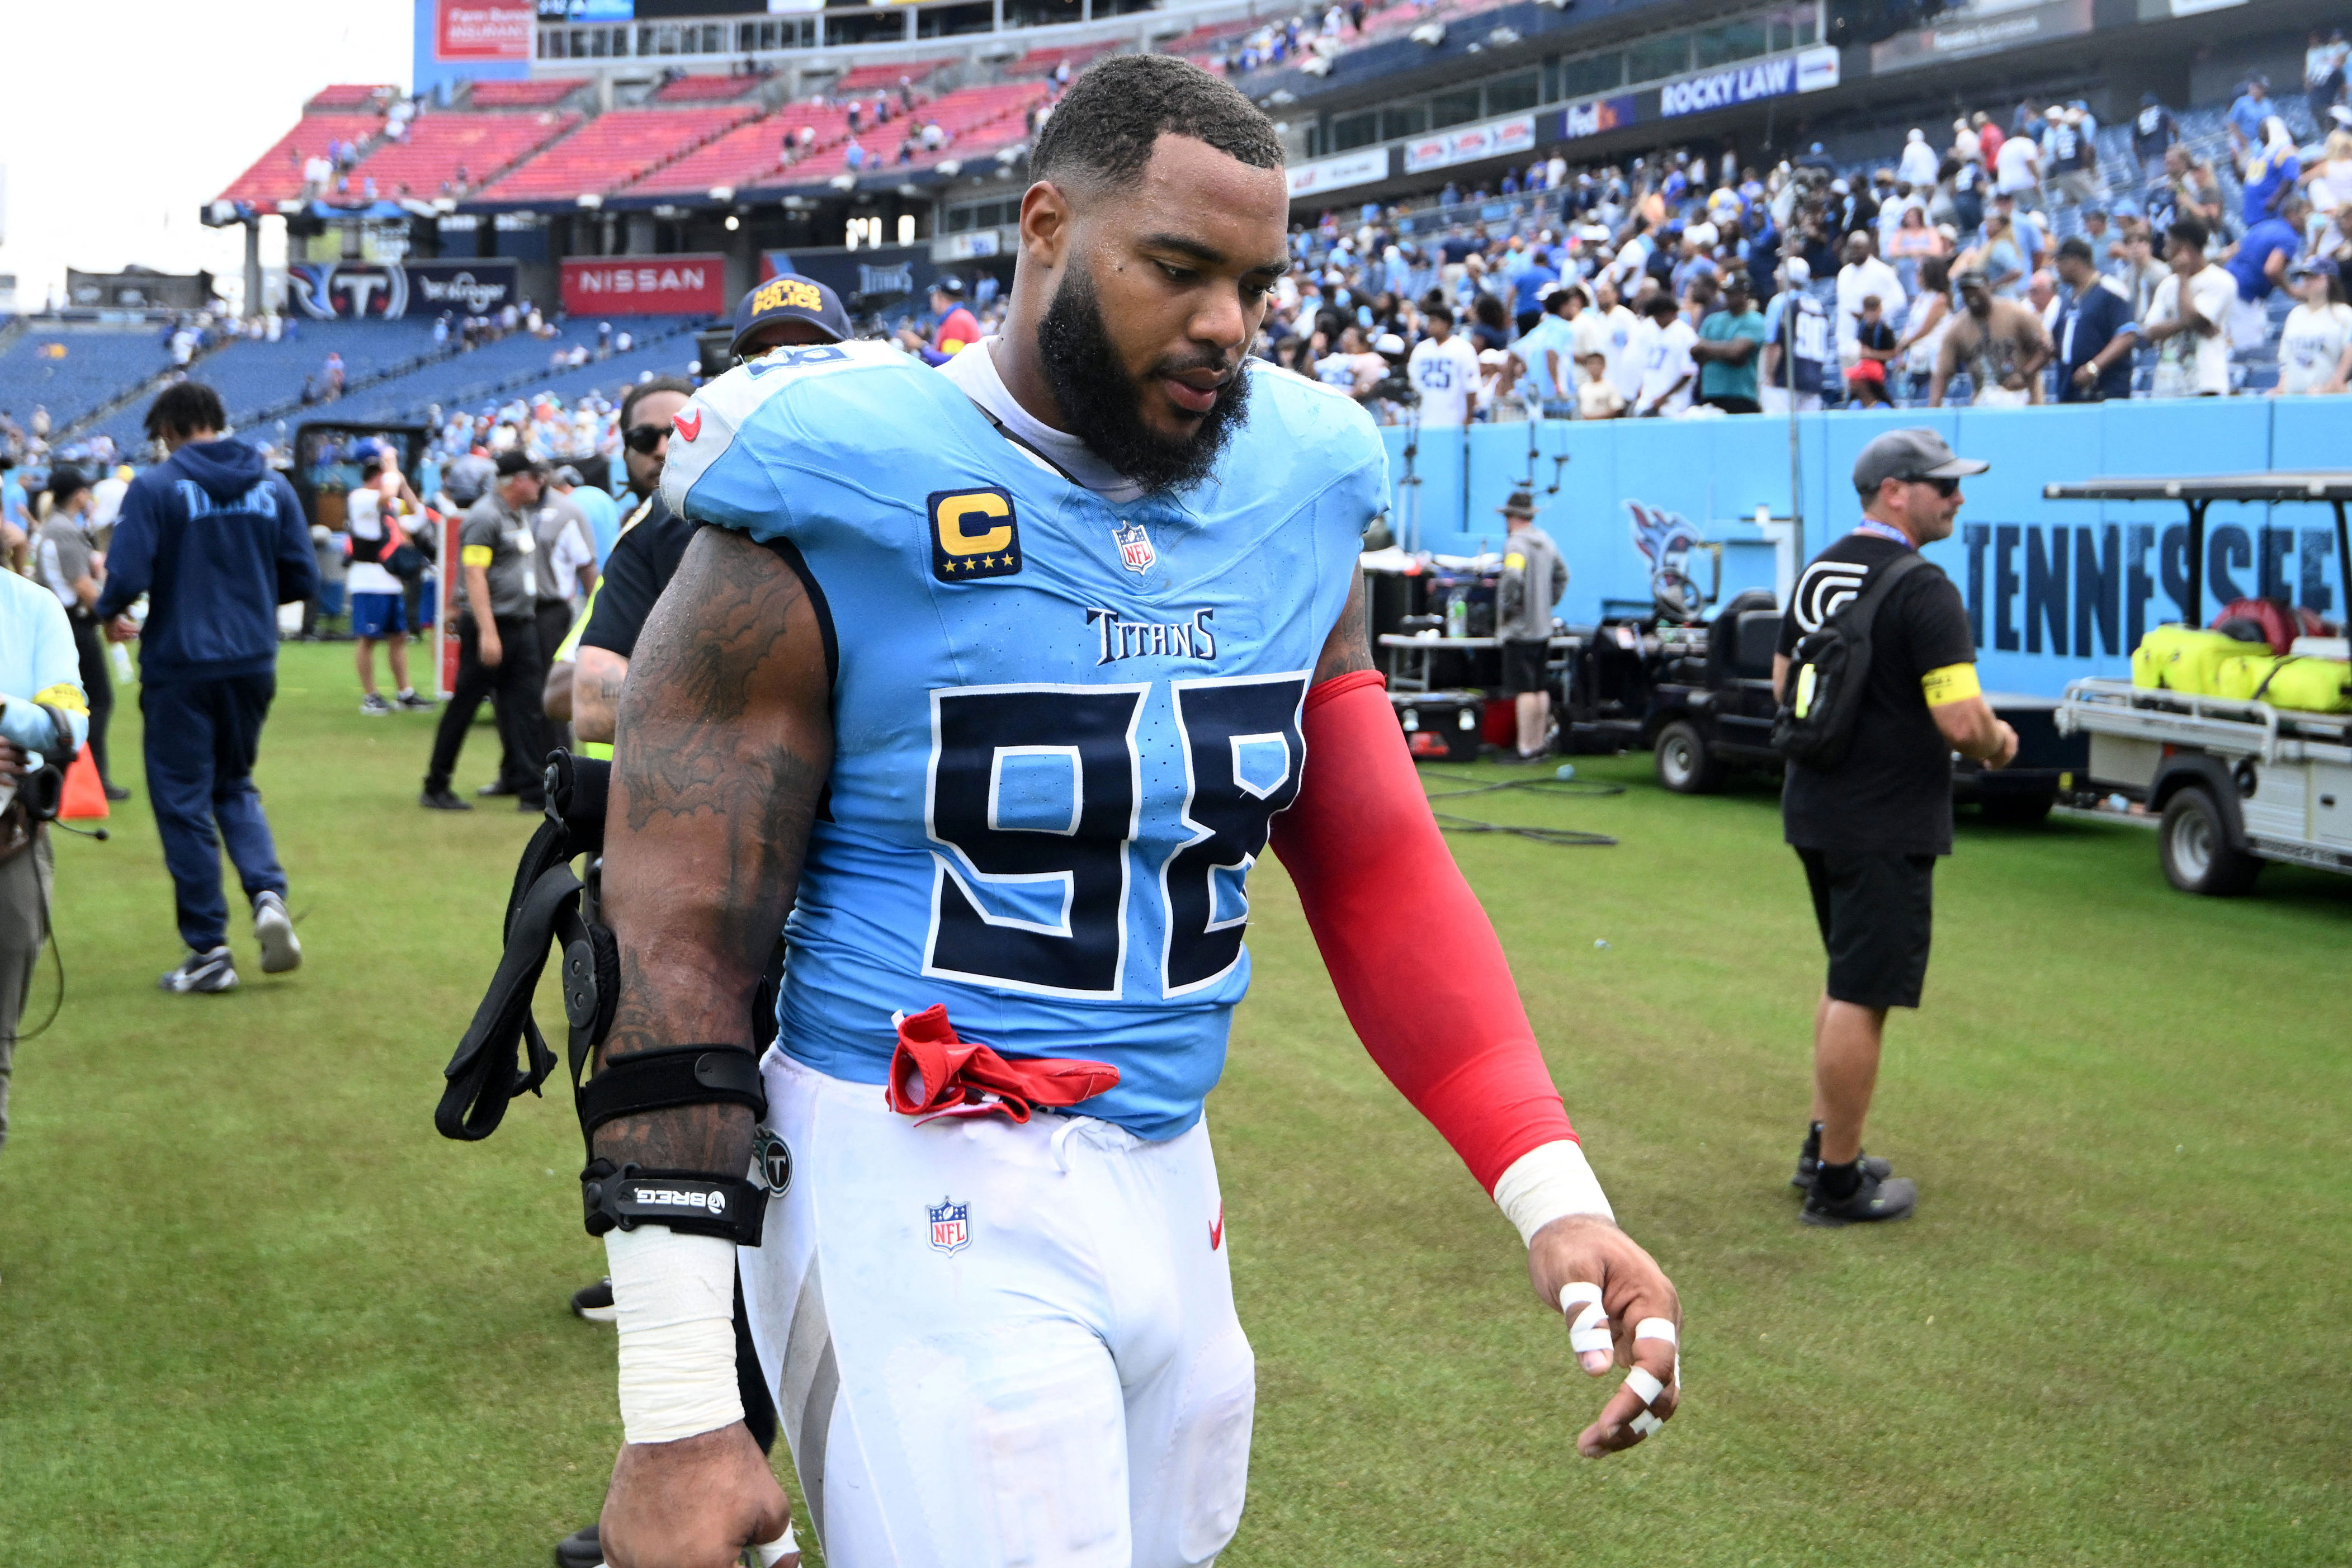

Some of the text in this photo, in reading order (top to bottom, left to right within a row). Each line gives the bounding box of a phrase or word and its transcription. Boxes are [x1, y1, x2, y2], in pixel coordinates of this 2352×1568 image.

[1661, 56, 1791, 117] ROCKY LAW
[579, 266, 705, 293] NISSAN
[755, 280, 821, 302] METRO
[752, 293, 823, 317] POLICE
[1419, 358, 1452, 389] 25
[937, 492, 1013, 557] C
[1125, 543, 1150, 564] NFL
[922, 670, 1312, 1001] 98
[636, 1189, 707, 1208] BREG
[934, 1222, 965, 1245] NFL
